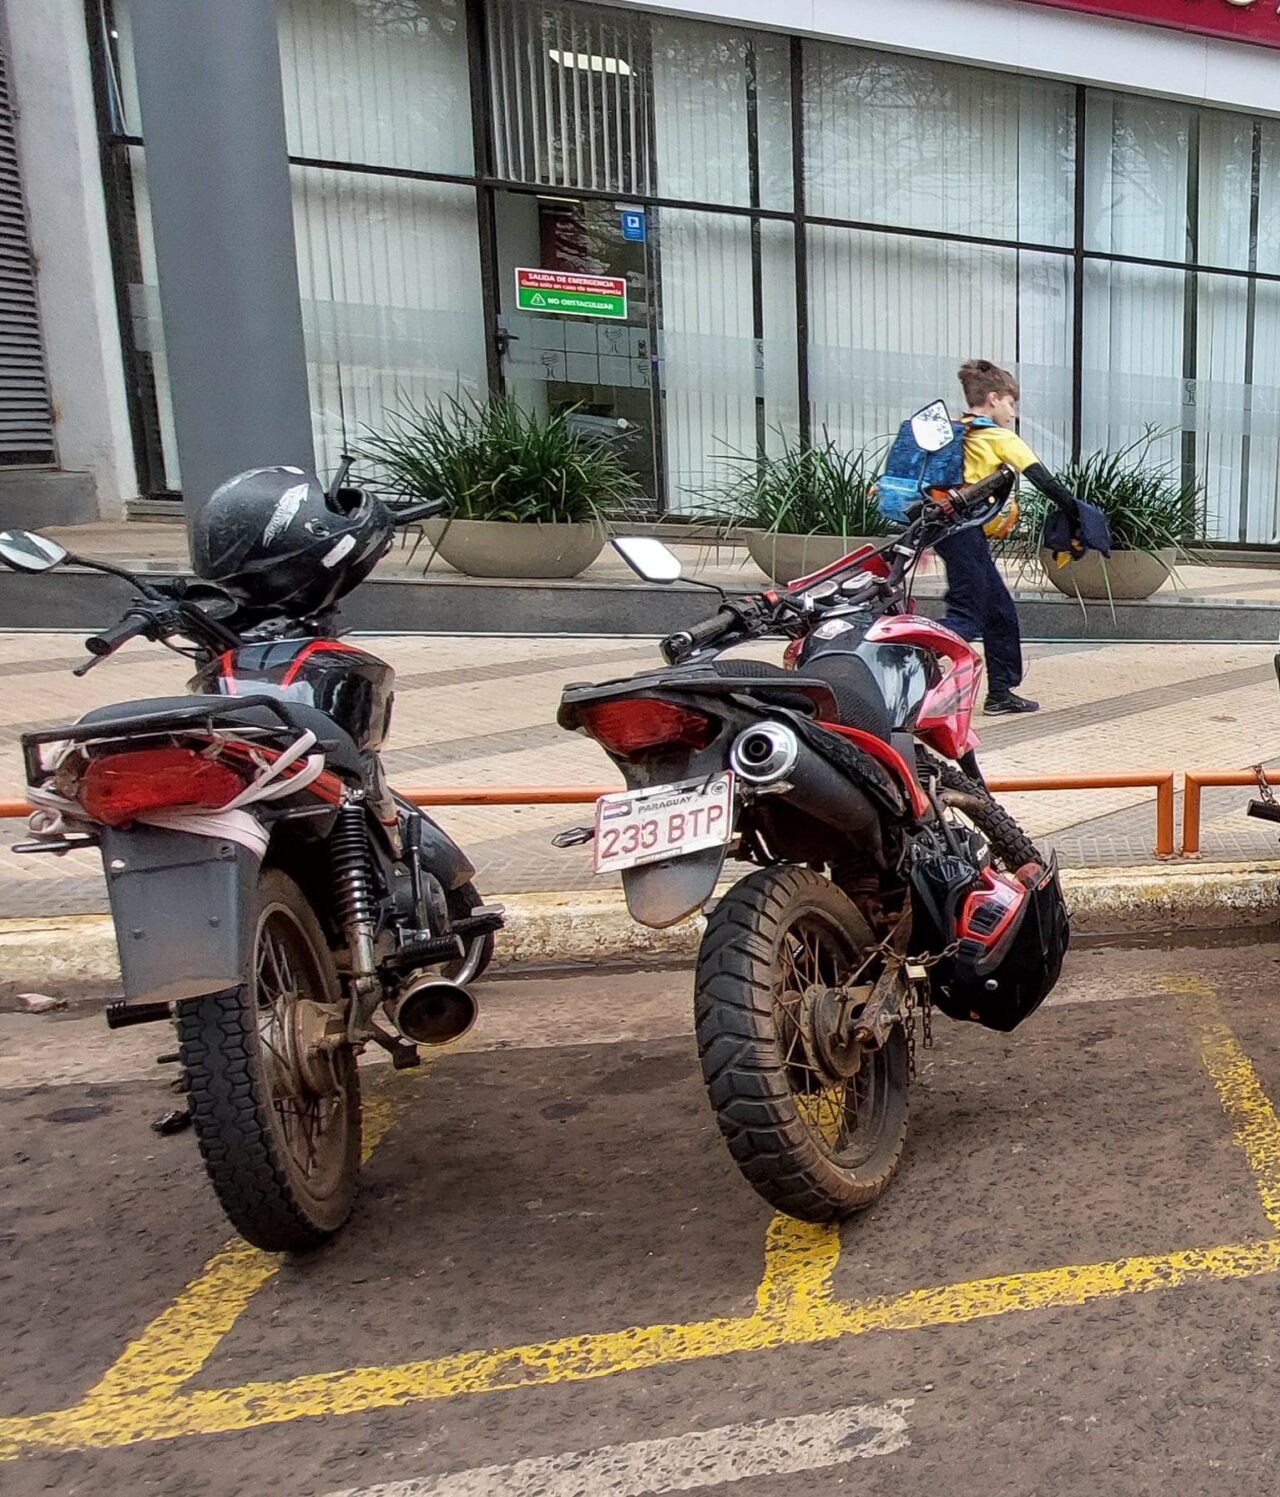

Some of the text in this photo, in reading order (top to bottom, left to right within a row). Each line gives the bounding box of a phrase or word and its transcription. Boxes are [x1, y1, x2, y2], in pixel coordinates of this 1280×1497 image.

[637, 795, 693, 814] PARAGUAY
[601, 804, 723, 859] 233 BTP
